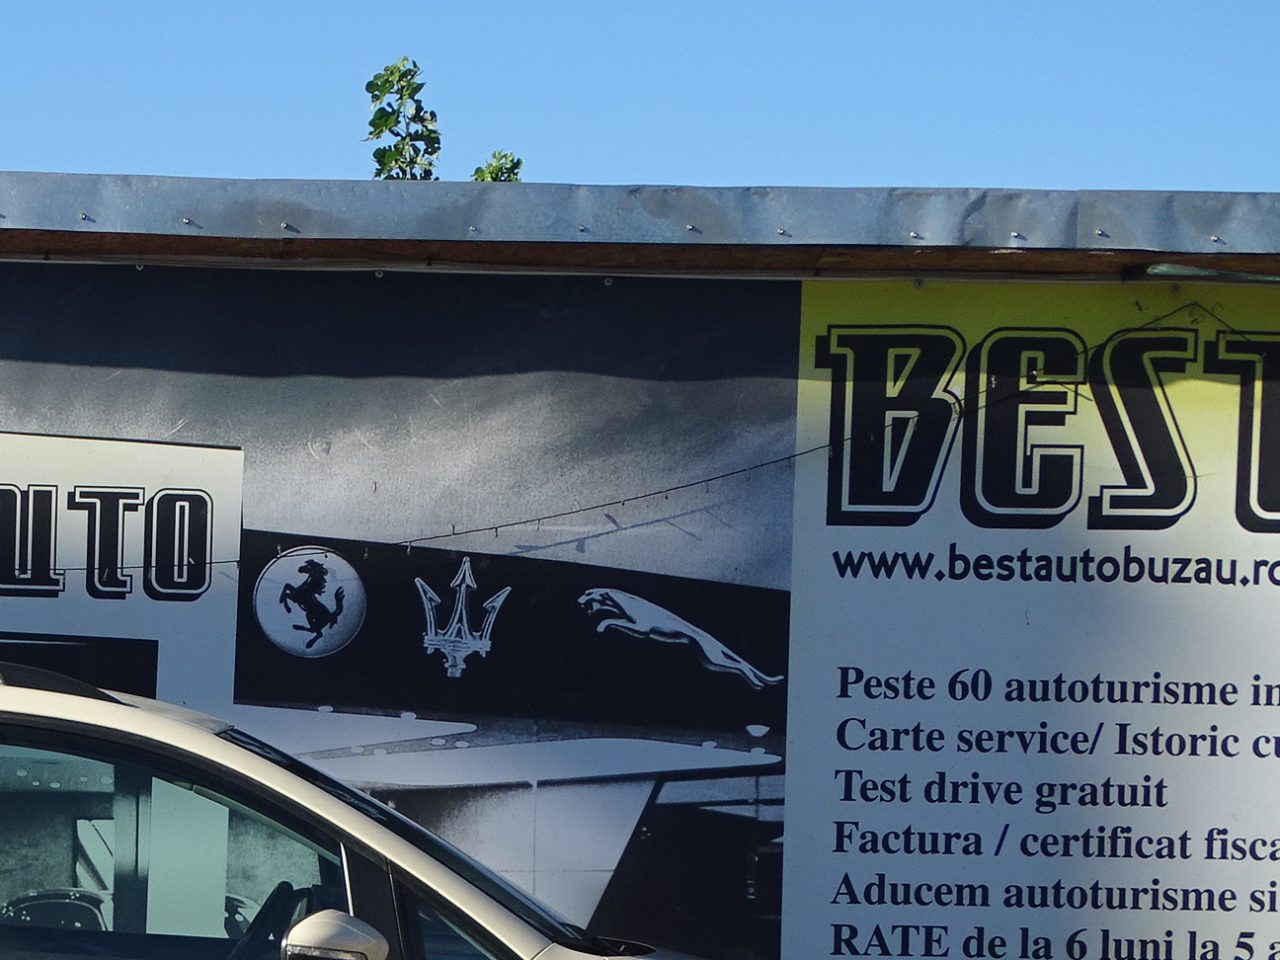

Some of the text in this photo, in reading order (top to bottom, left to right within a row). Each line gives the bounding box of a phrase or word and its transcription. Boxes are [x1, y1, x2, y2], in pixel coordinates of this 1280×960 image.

[836, 666, 936, 702] Peste
[948, 668, 993, 702] 60
[1004, 672, 1239, 706] autoturisme
[836, 717, 946, 753] Carte
[956, 720, 1105, 756] service/
[1114, 722, 1240, 758] Istoric
[834, 769, 1169, 814] Test drive gratuit
[832, 821, 984, 856] Factura
[1019, 825, 1192, 860] certificat
[830, 872, 991, 909] Aducem
[1003, 878, 1238, 912] autoturisme
[830, 924, 950, 958] RATE
[962, 926, 1008, 960] de
[1019, 927, 1053, 960] la
